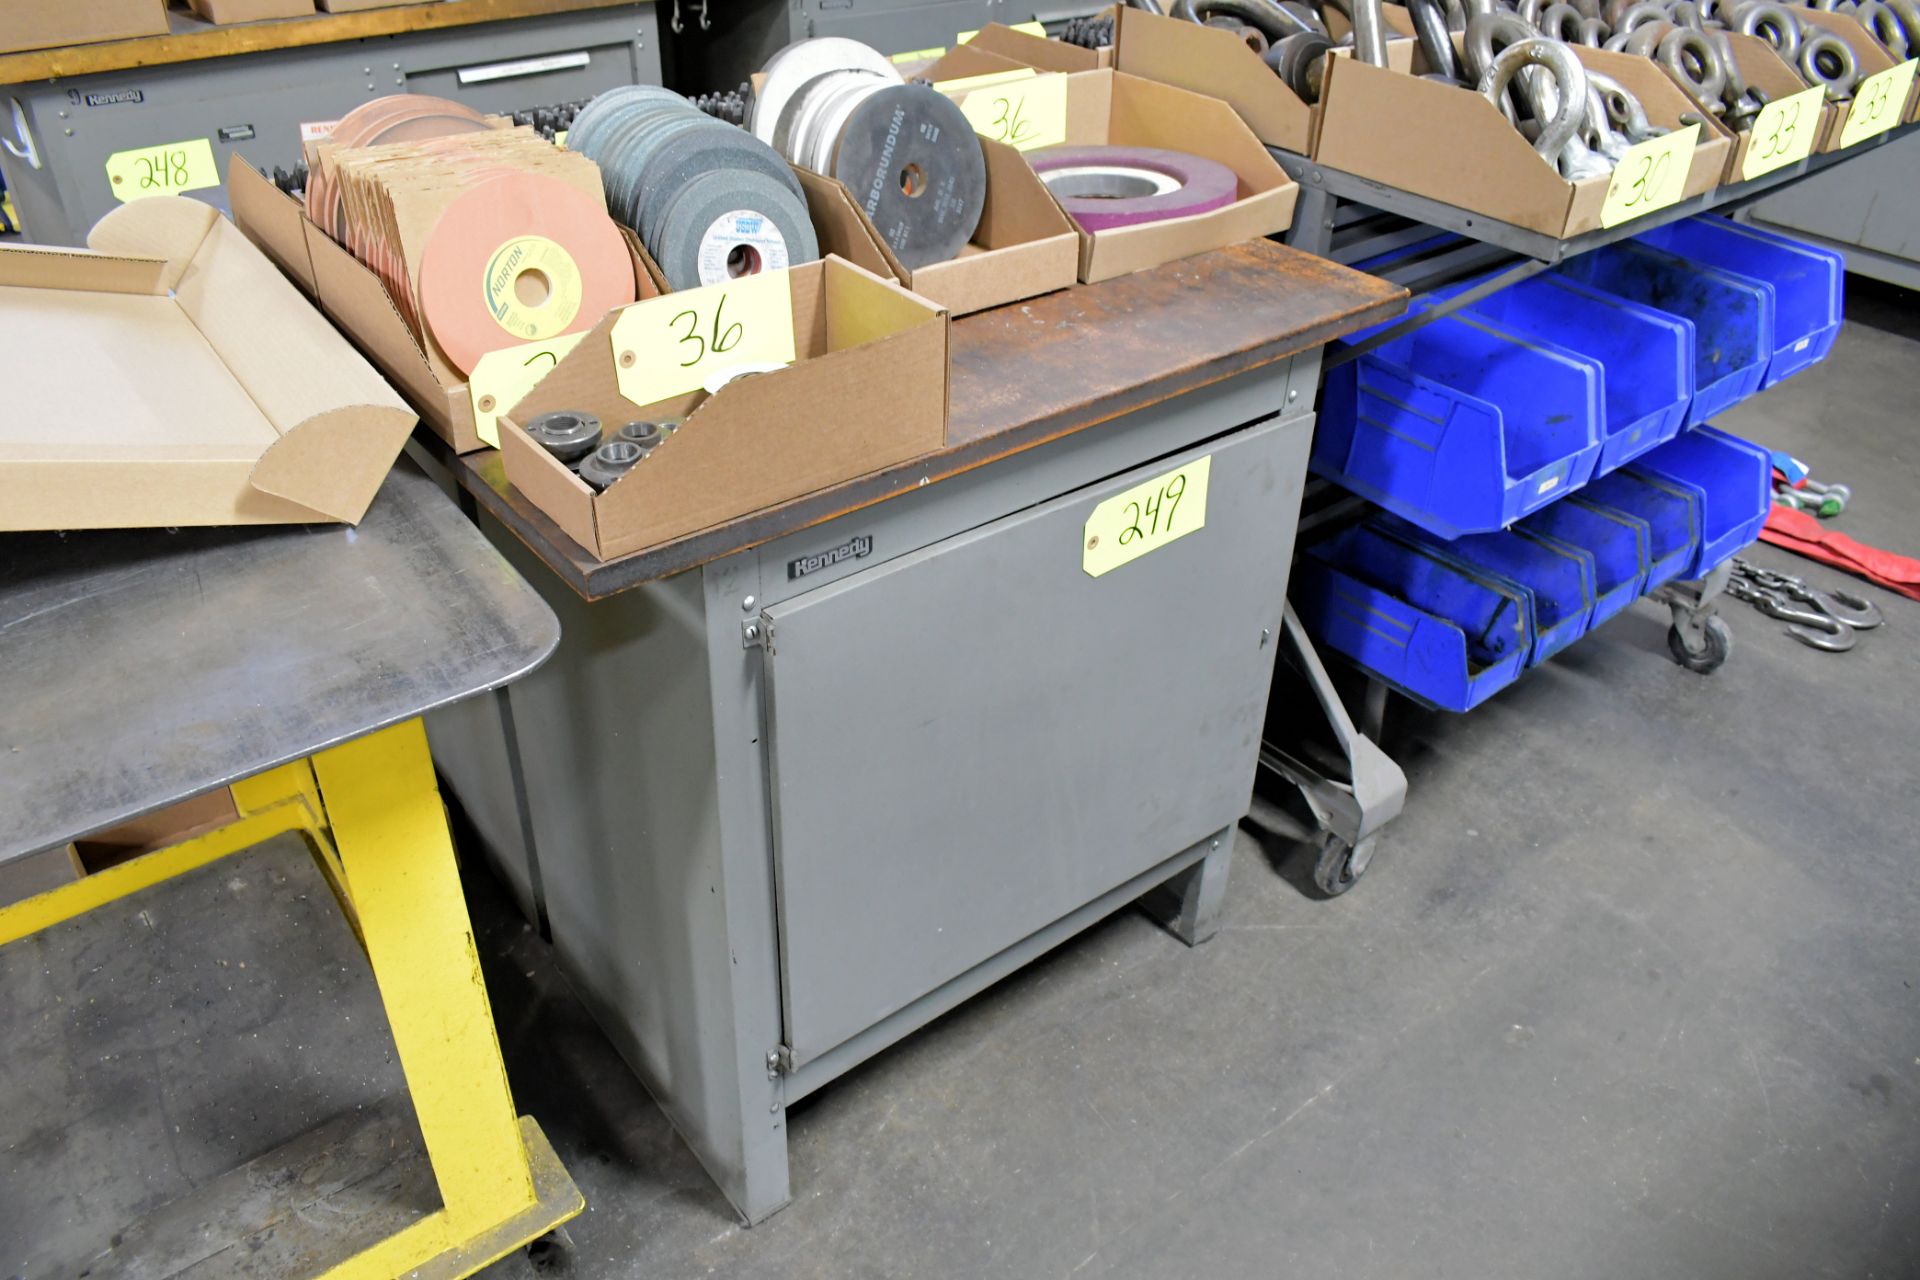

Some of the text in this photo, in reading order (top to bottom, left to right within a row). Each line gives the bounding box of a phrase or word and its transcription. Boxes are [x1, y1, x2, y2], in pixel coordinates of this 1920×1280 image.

[88, 89, 142, 106] Kennedy
[991, 95, 1032, 142] 36
[1859, 77, 1892, 125] 33
[1762, 102, 1800, 159] 33
[134, 150, 189, 190] 248
[864, 108, 905, 221] ARBORUNDUM
[1625, 150, 1671, 207] 30
[492, 246, 523, 296] NORTON
[669, 294, 743, 367] 36
[1119, 474, 1186, 545] 249
[793, 535, 871, 578] Kennedy
